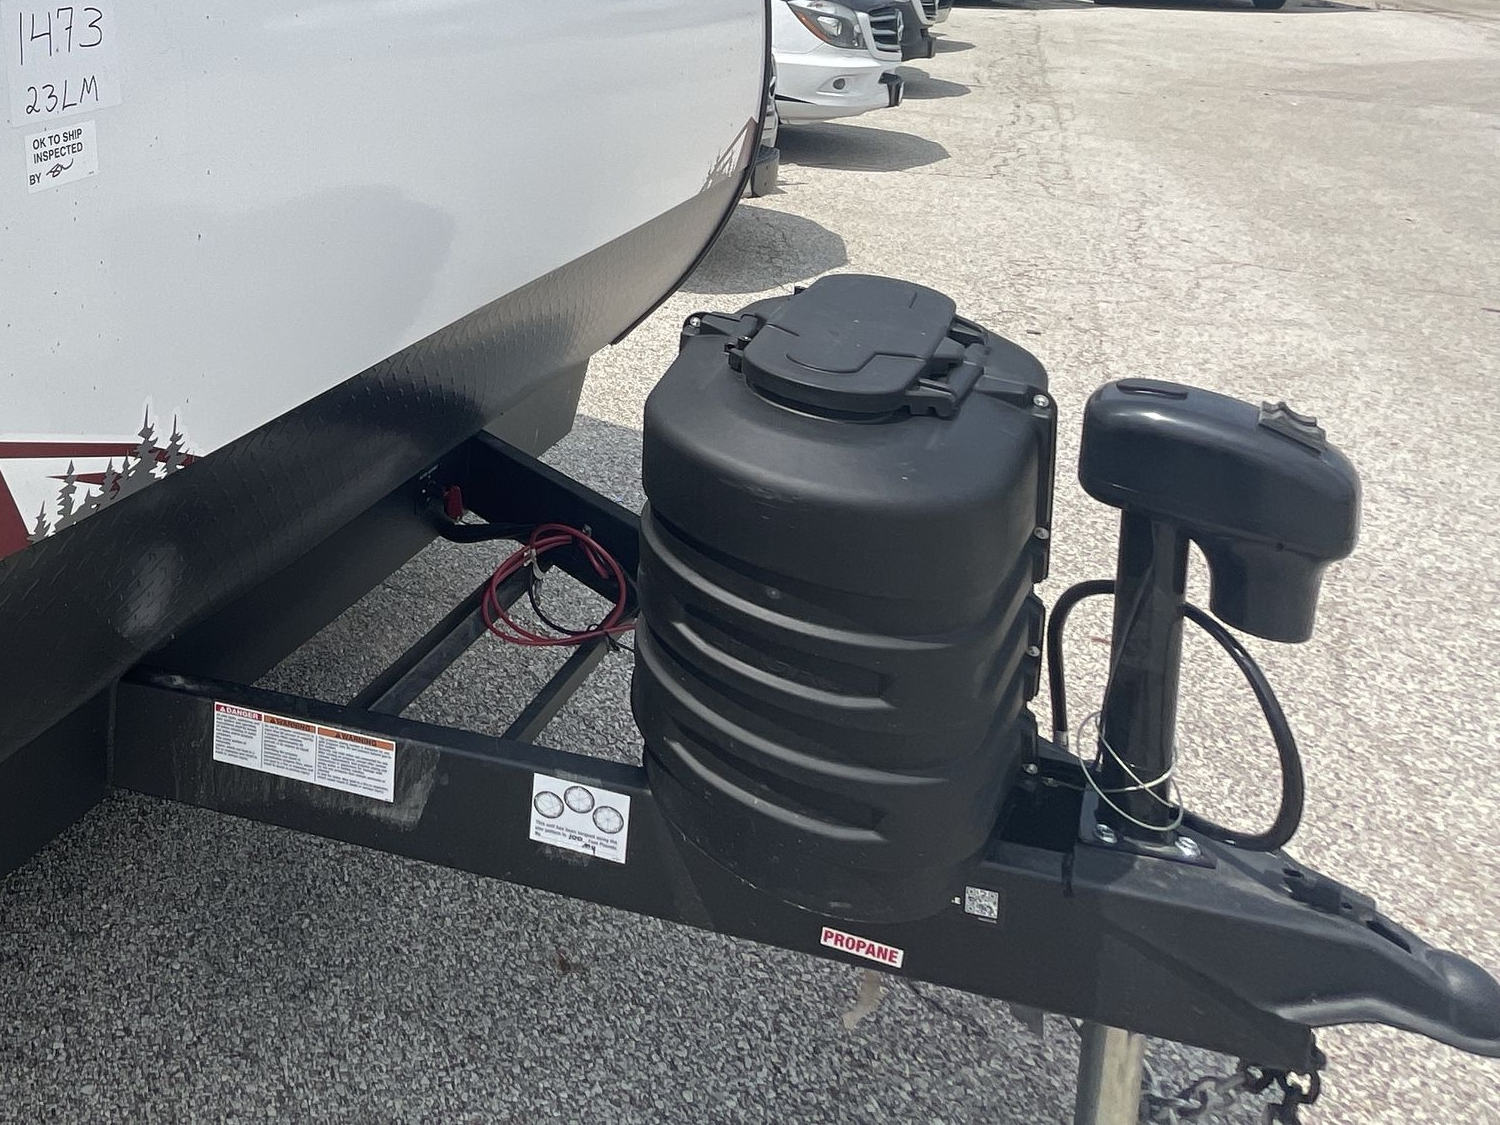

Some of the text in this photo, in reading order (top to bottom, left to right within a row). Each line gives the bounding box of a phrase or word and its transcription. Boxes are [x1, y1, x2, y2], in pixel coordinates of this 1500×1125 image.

[19, 6, 104, 66] 1473
[25, 75, 99, 115] 23LM
[32, 128, 83, 150] OK TO SHIP
[33, 141, 84, 164] INSPECTED
[29, 173, 42, 186] BY
[226, 707, 259, 720] DANGER
[275, 718, 310, 732] WARNING
[340, 733, 377, 746] WARNING
[822, 930, 899, 964] PROPANE
